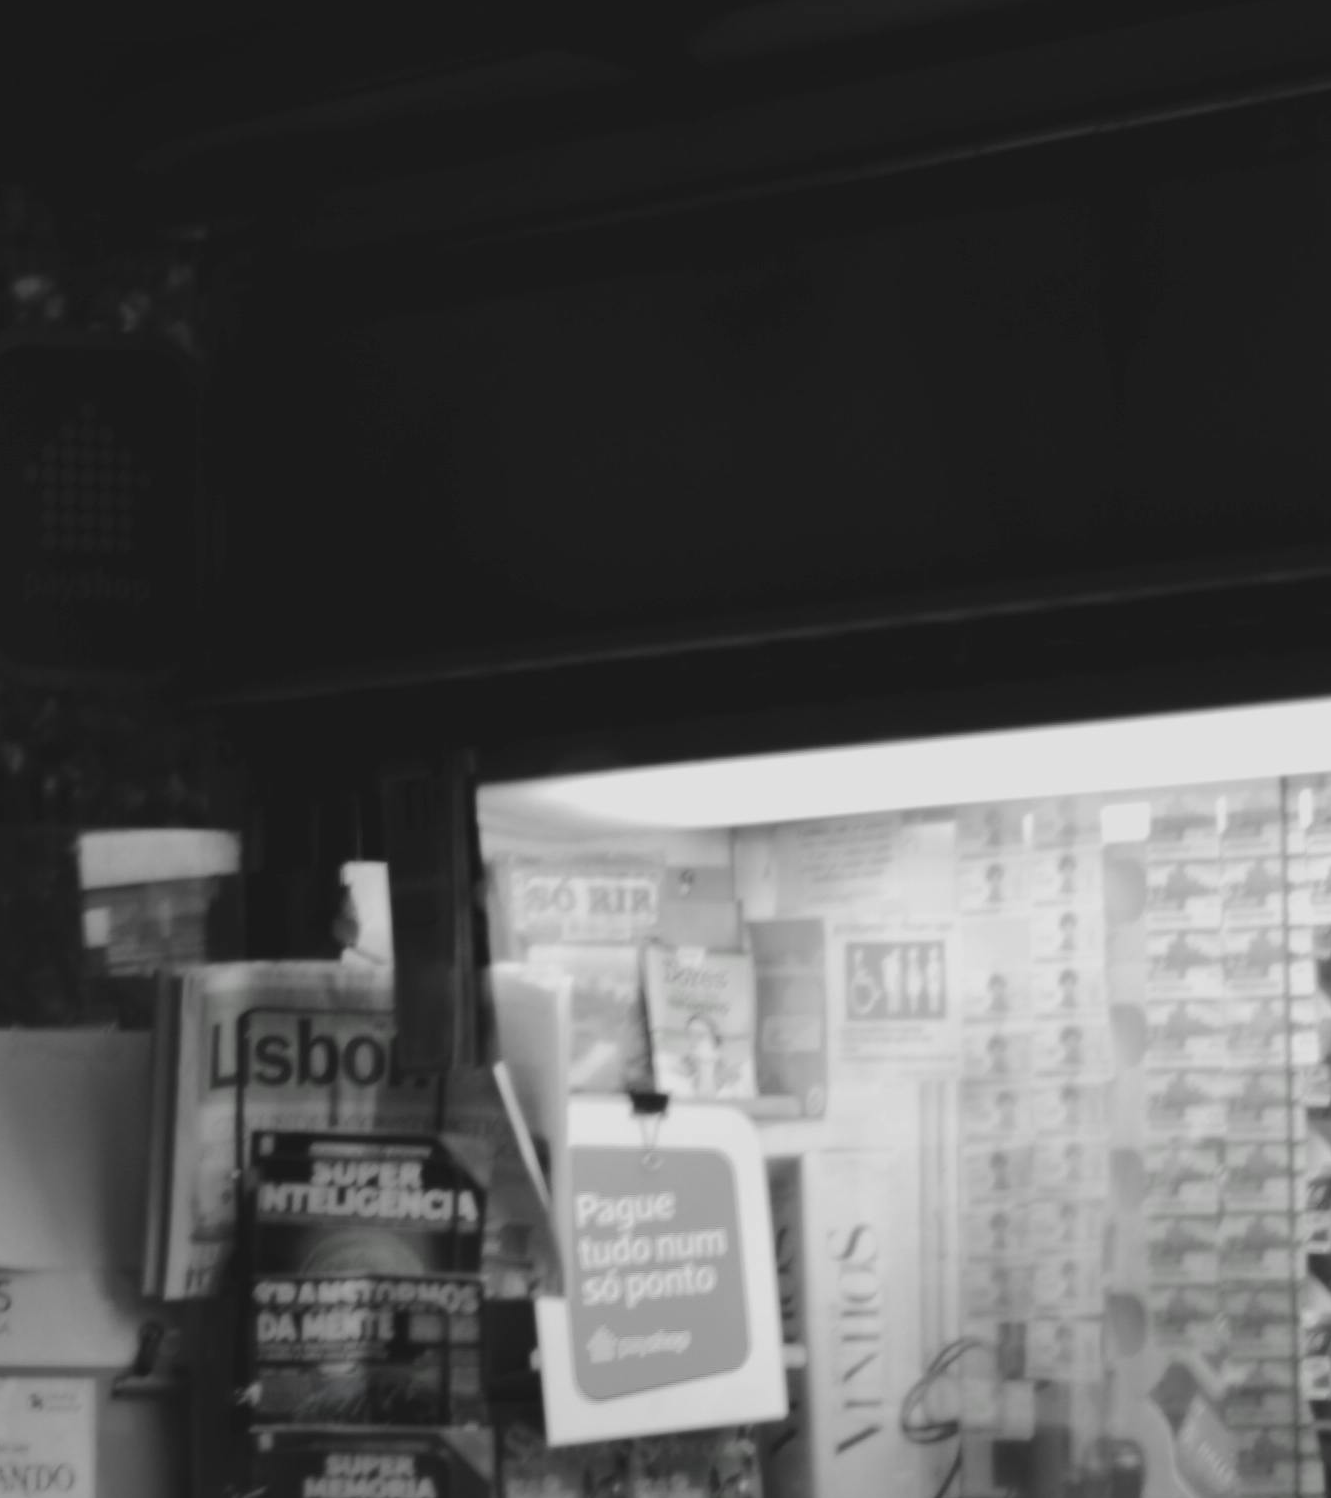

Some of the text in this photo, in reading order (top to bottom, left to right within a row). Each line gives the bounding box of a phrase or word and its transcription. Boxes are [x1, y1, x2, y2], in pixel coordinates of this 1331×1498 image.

[23, 568, 151, 606] payshop
[576, 1191, 676, 1231] Pague
[578, 1227, 728, 1271] tudo num
[581, 1262, 719, 1310] só ponto
